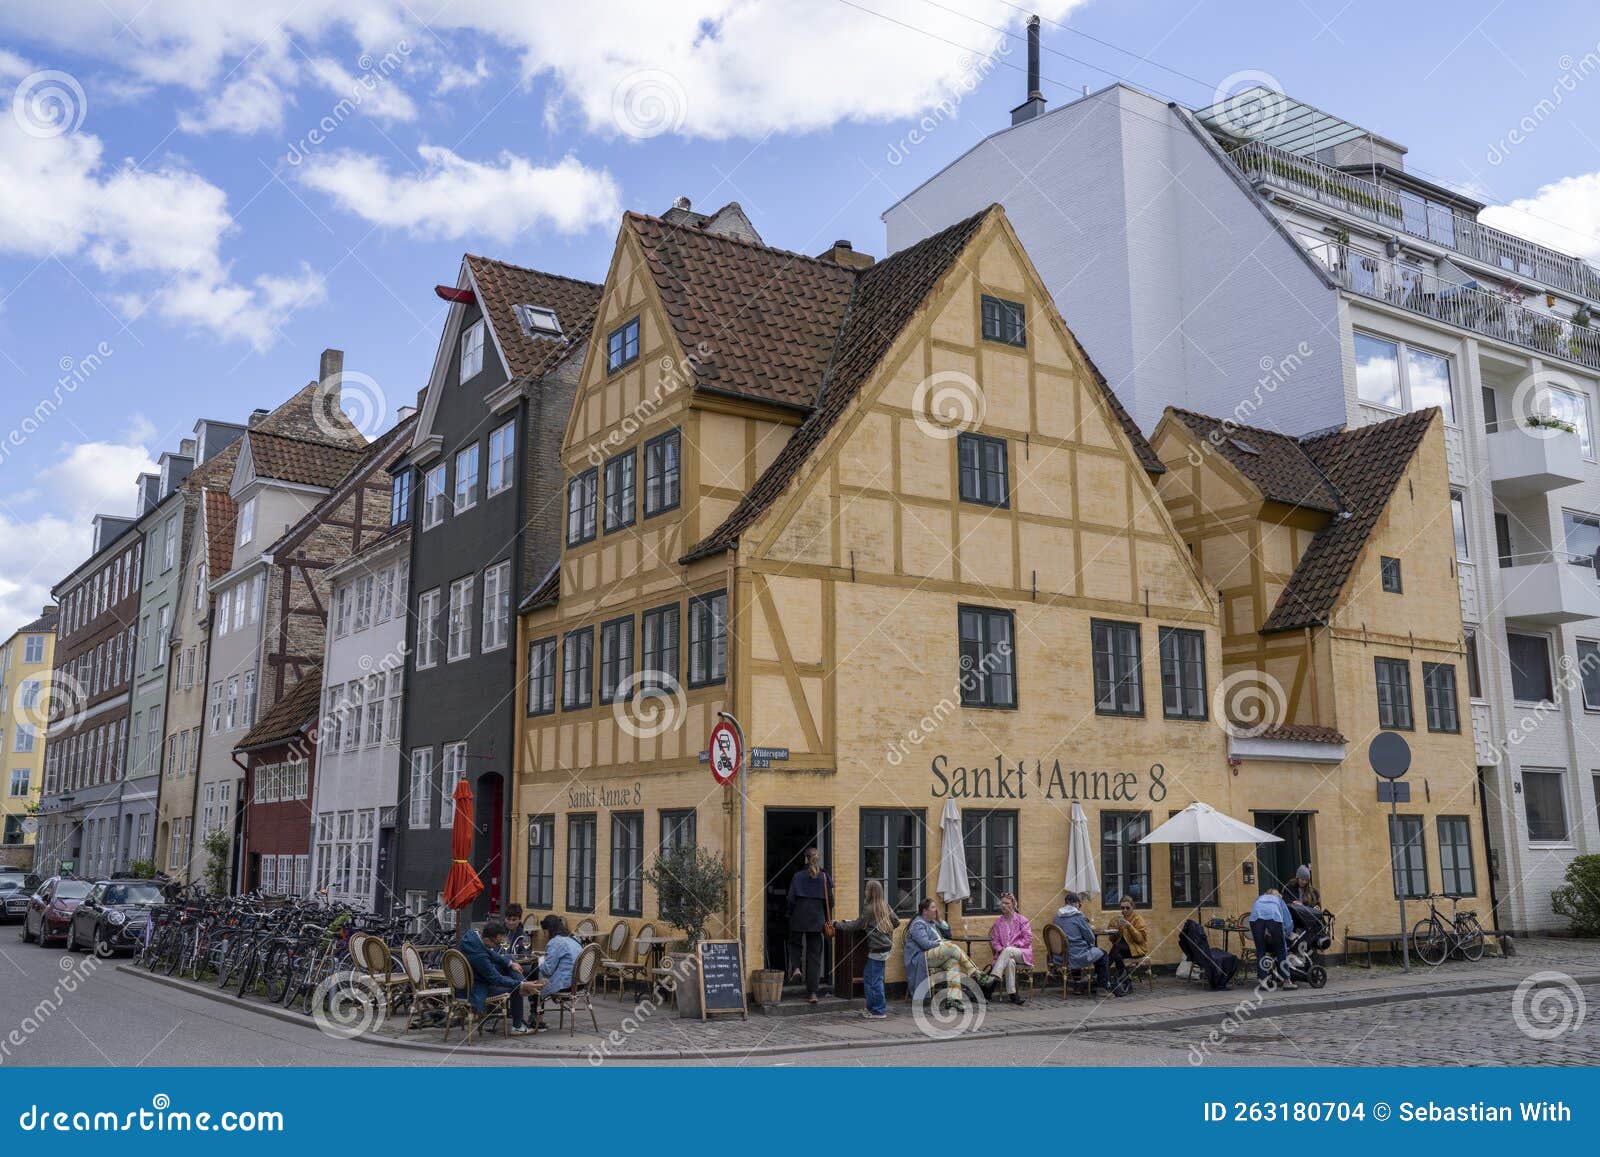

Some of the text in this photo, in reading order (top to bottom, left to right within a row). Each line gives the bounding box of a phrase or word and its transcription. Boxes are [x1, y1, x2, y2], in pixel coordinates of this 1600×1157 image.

[568, 782, 641, 808] Sankt Annæ 8
[931, 754, 1167, 802] Sankt Annæ 8
